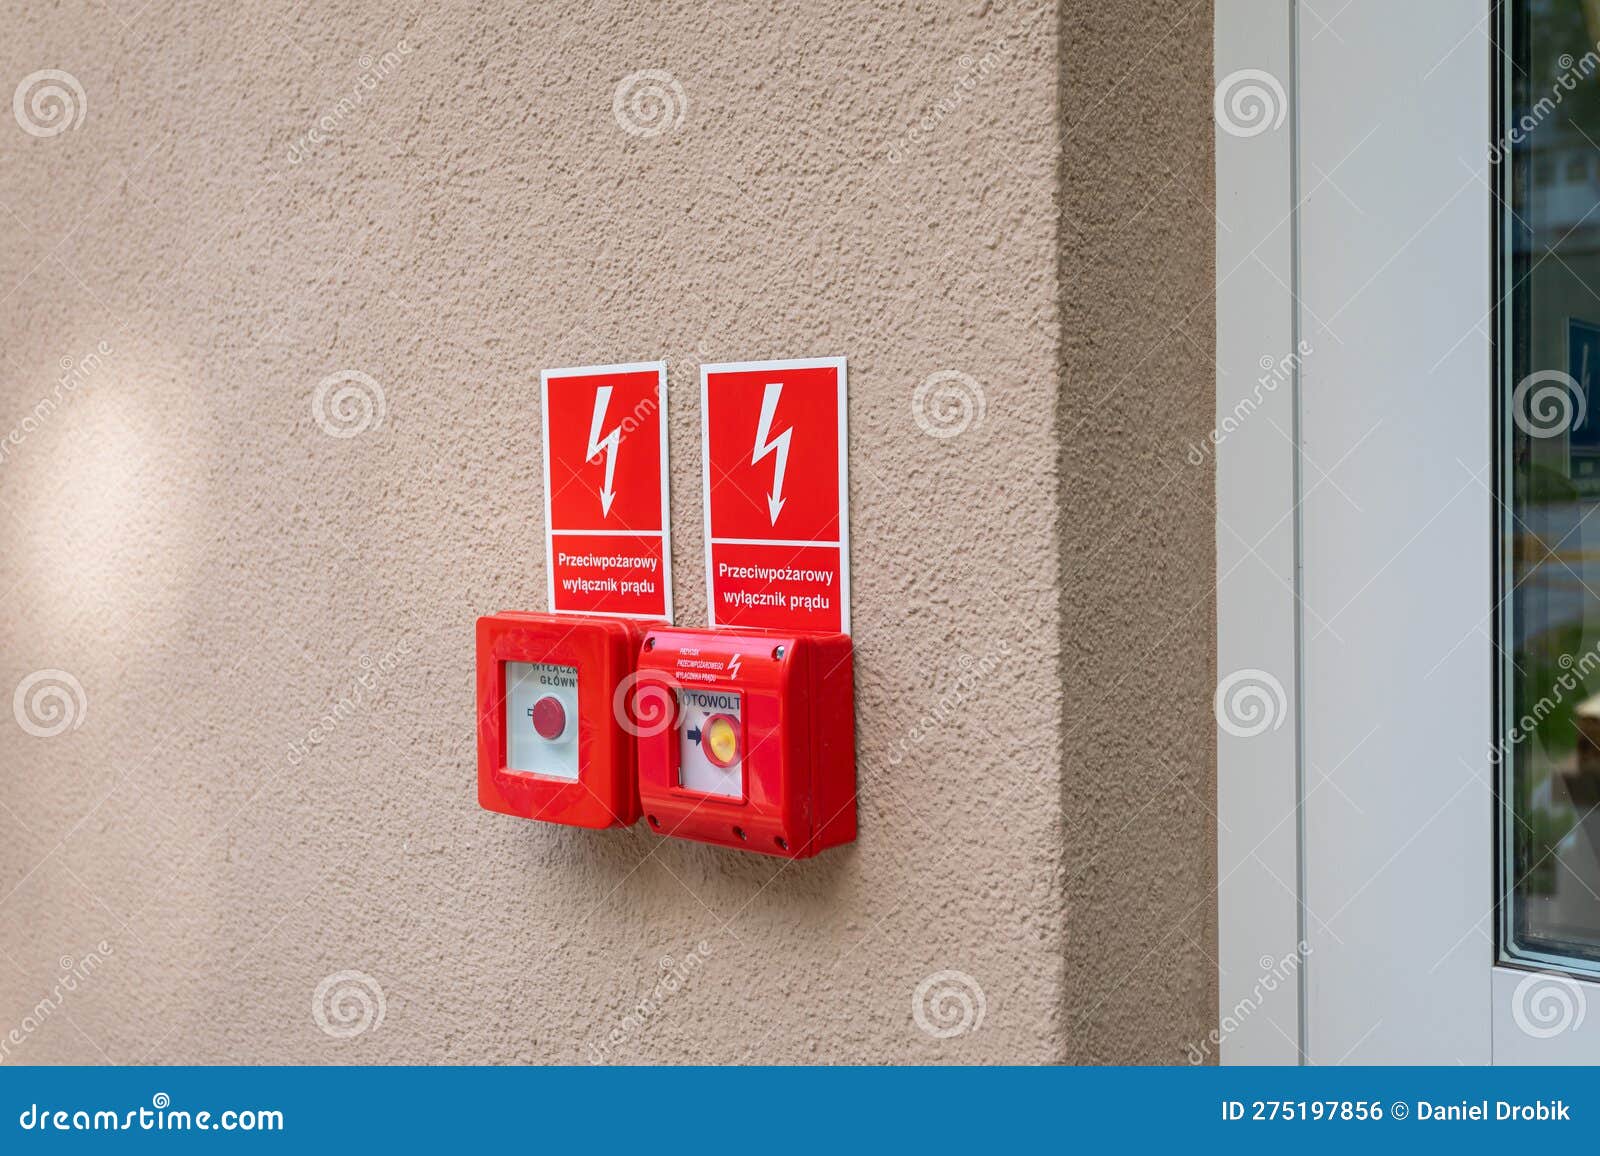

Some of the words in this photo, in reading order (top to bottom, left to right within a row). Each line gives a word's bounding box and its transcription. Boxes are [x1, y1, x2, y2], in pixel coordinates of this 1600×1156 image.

[558, 552, 658, 572] Przeciwpożarowy
[719, 563, 833, 586] Przeciwpożarowy
[562, 577, 618, 594] wyłącznik
[621, 579, 655, 596] prądu
[723, 589, 787, 608] wyłącznik
[790, 594, 830, 613] prądu
[540, 675, 578, 688] GŁÓWN
